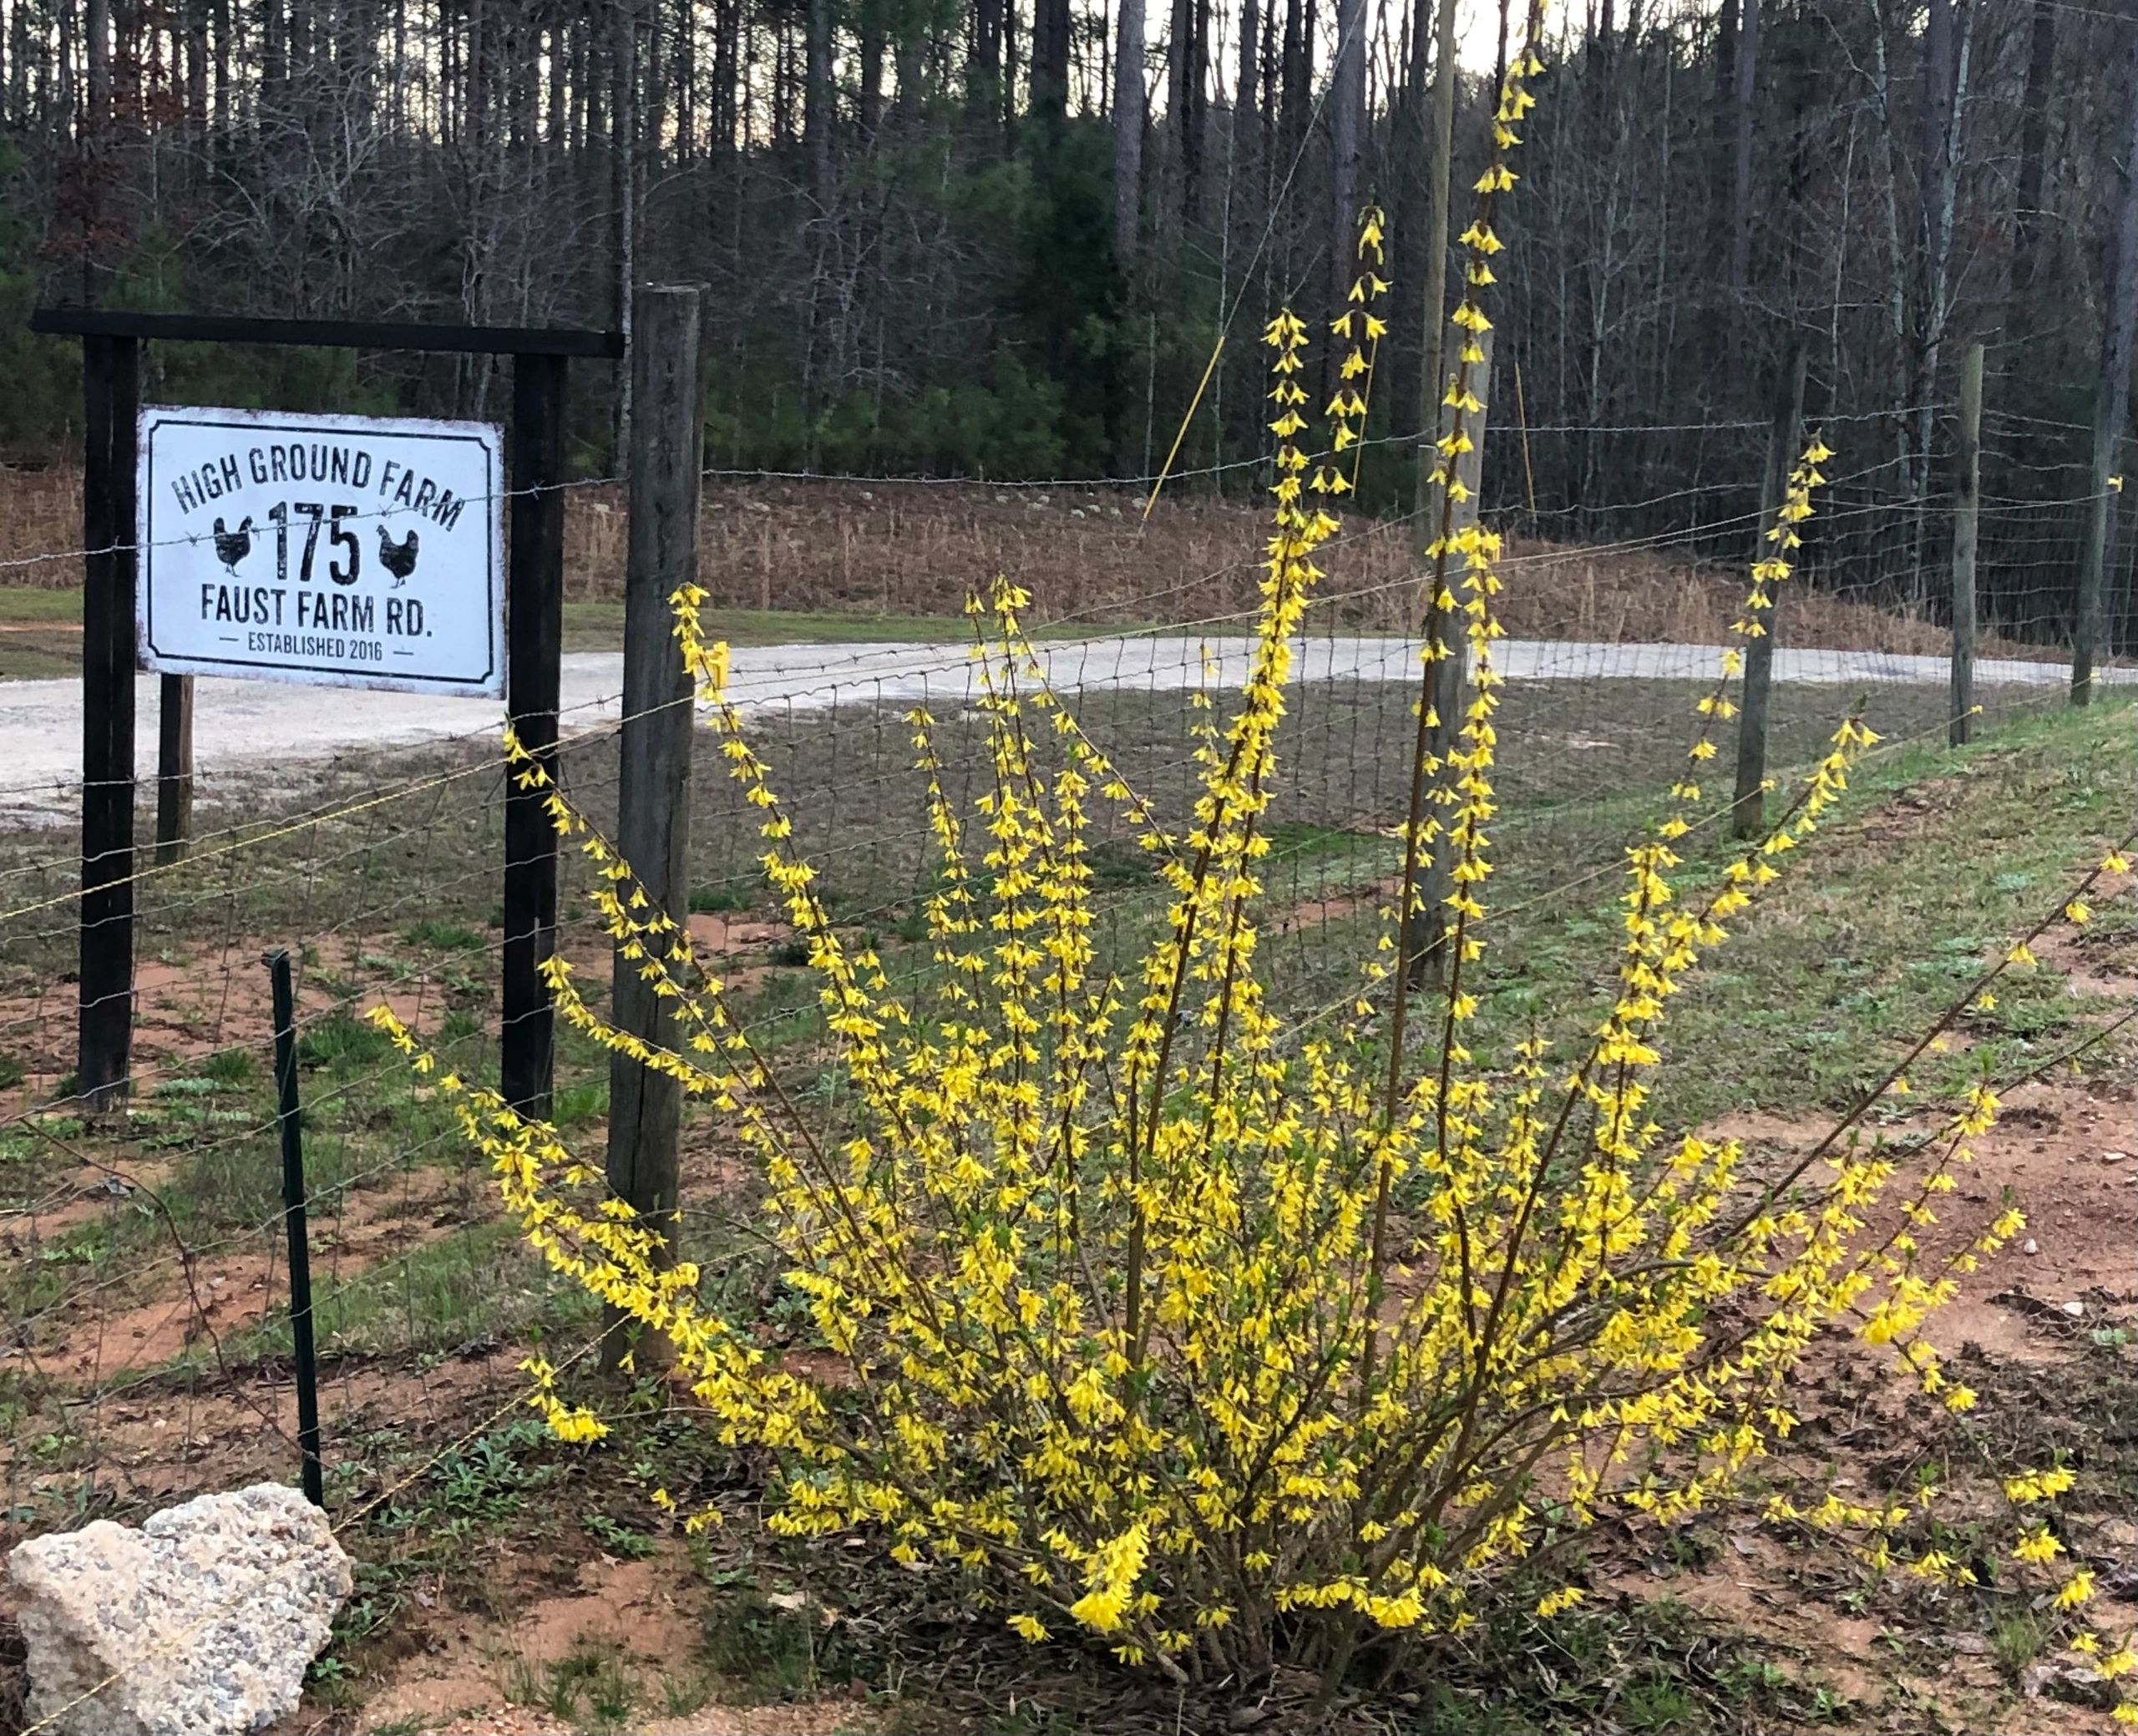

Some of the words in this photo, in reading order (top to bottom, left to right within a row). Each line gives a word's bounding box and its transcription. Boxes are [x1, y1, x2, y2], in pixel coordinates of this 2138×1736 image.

[171, 453, 243, 514] HIGH
[249, 443, 372, 489] GROUND
[379, 460, 465, 532] FARM
[269, 501, 360, 585] 175
[201, 584, 286, 626] FAUST
[297, 591, 374, 633] FARM
[387, 598, 433, 637] RD.
[248, 632, 345, 658] ESTABLISHED
[350, 640, 383, 661] 2016
